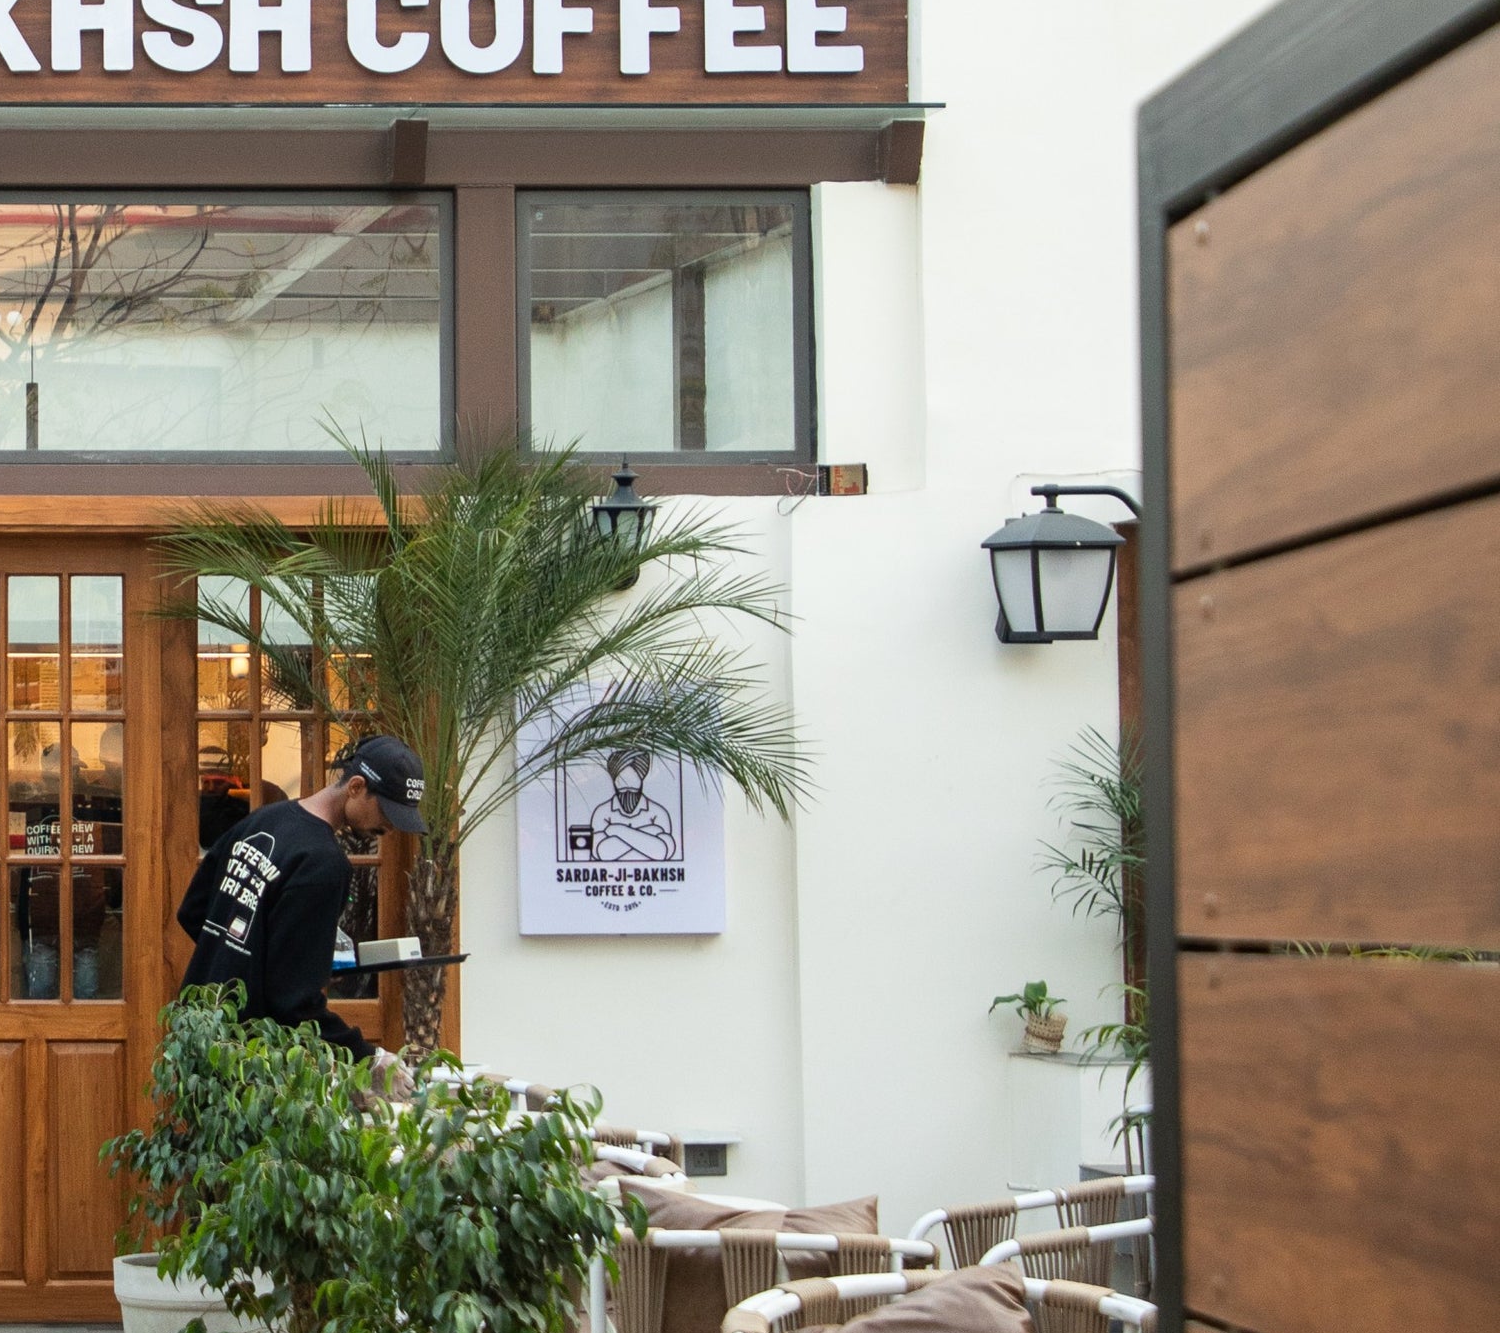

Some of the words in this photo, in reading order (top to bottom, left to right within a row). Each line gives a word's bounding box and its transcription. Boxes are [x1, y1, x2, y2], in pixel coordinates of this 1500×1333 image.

[71, 823, 94, 833] REW
[27, 835, 52, 845] WITH
[87, 833, 94, 842] A
[71, 844, 94, 854] REW
[585, 885, 624, 896] COFFEE
[627, 885, 636, 896] &
[640, 885, 656, 896] CO.
